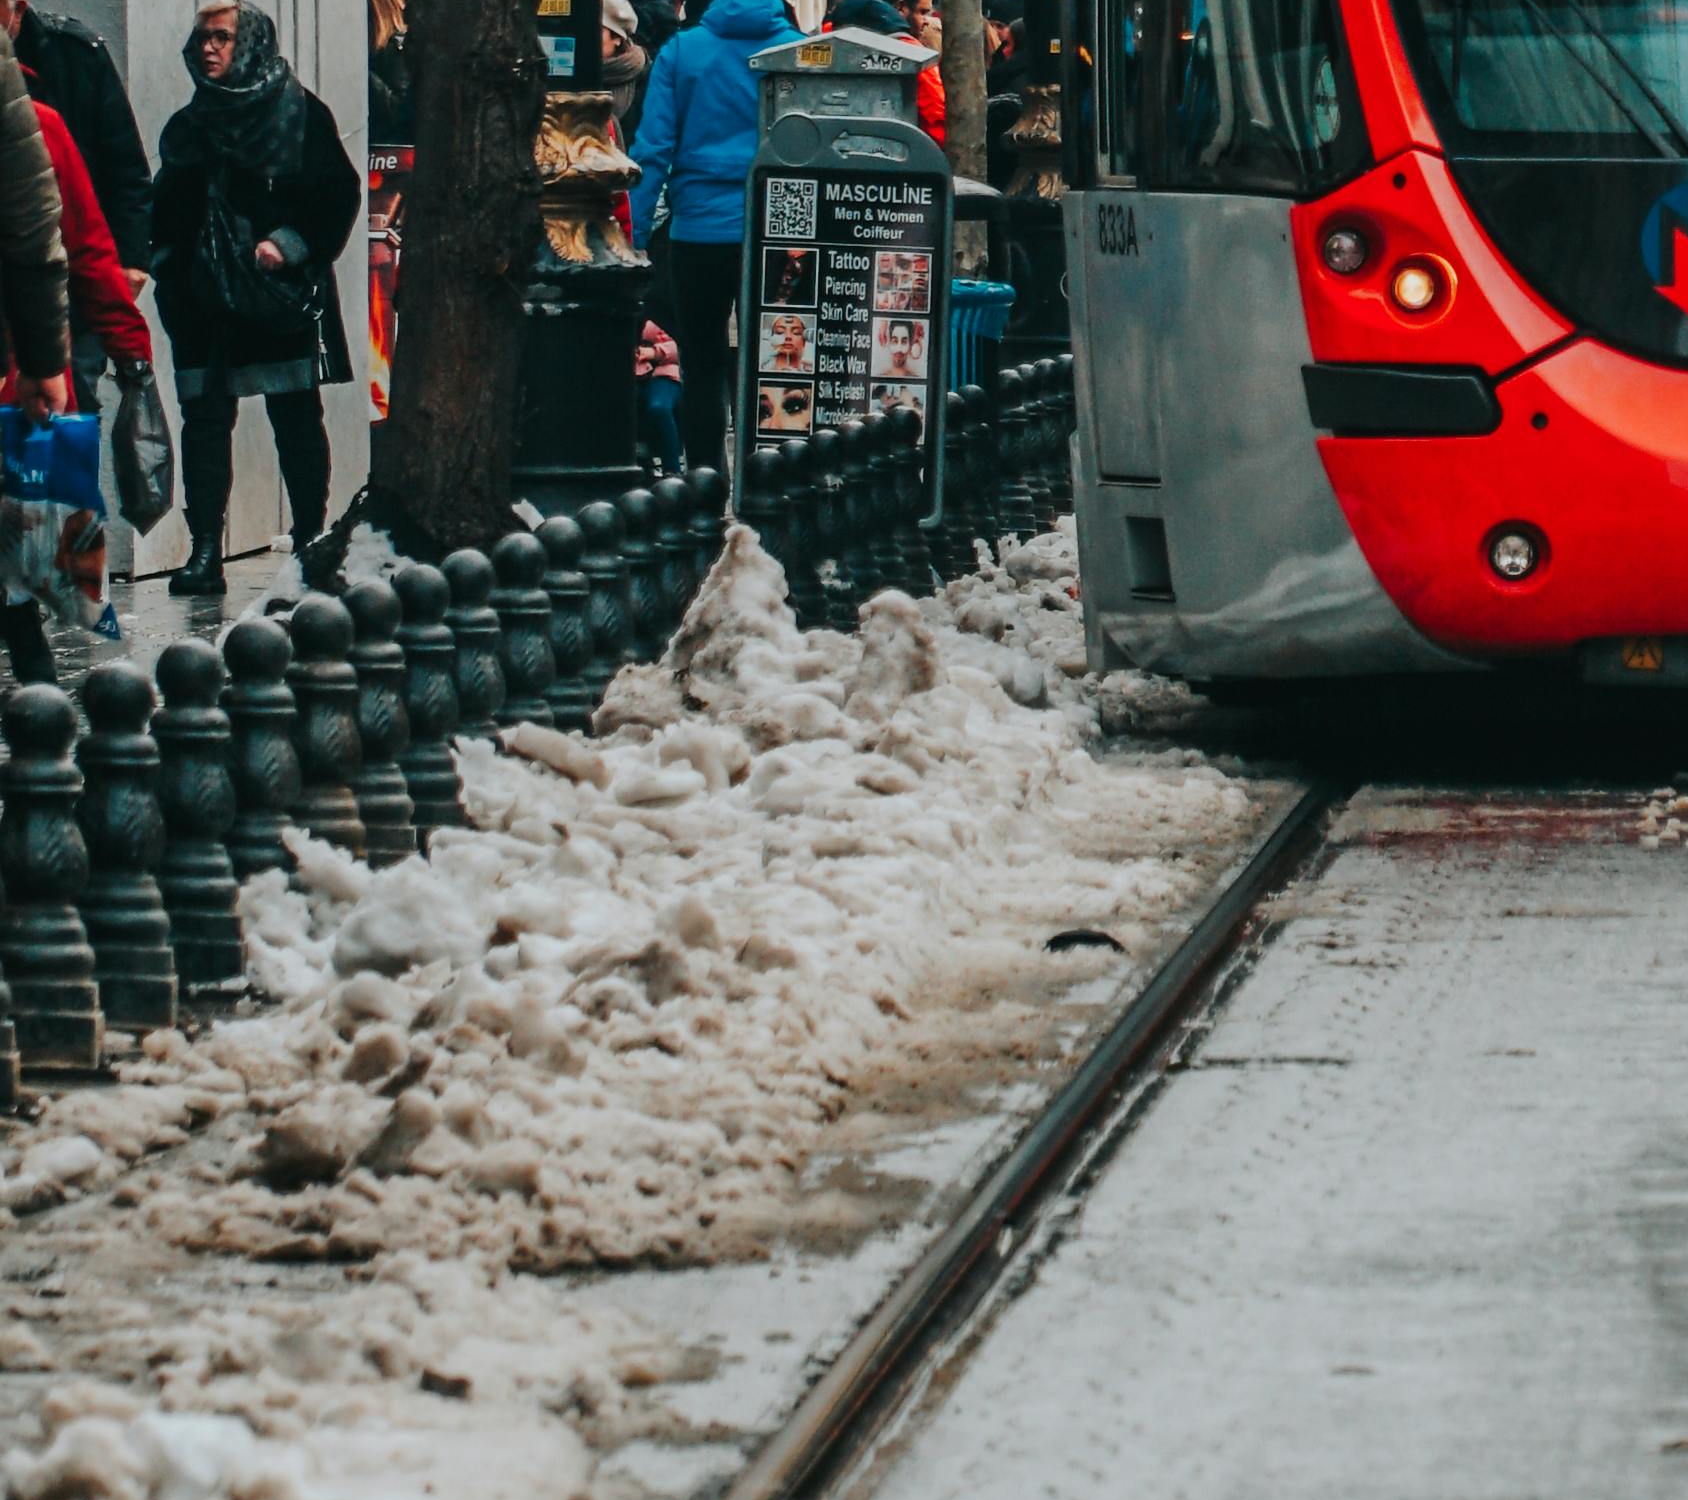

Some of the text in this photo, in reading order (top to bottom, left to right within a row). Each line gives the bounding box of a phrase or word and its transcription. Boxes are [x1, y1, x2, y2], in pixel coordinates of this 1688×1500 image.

[369, 153, 398, 170] ine
[826, 182, 932, 205] MASCULİNE
[835, 207, 924, 223] Men & Women
[854, 225, 904, 240] Coiffeur
[1099, 203, 1139, 257] 833A
[828, 250, 870, 270] Tattoo
[825, 276, 866, 300] Piercing
[821, 303, 869, 322] Skin Care
[852, 330, 871, 349] Face
[819, 354, 867, 374] Black Wax
